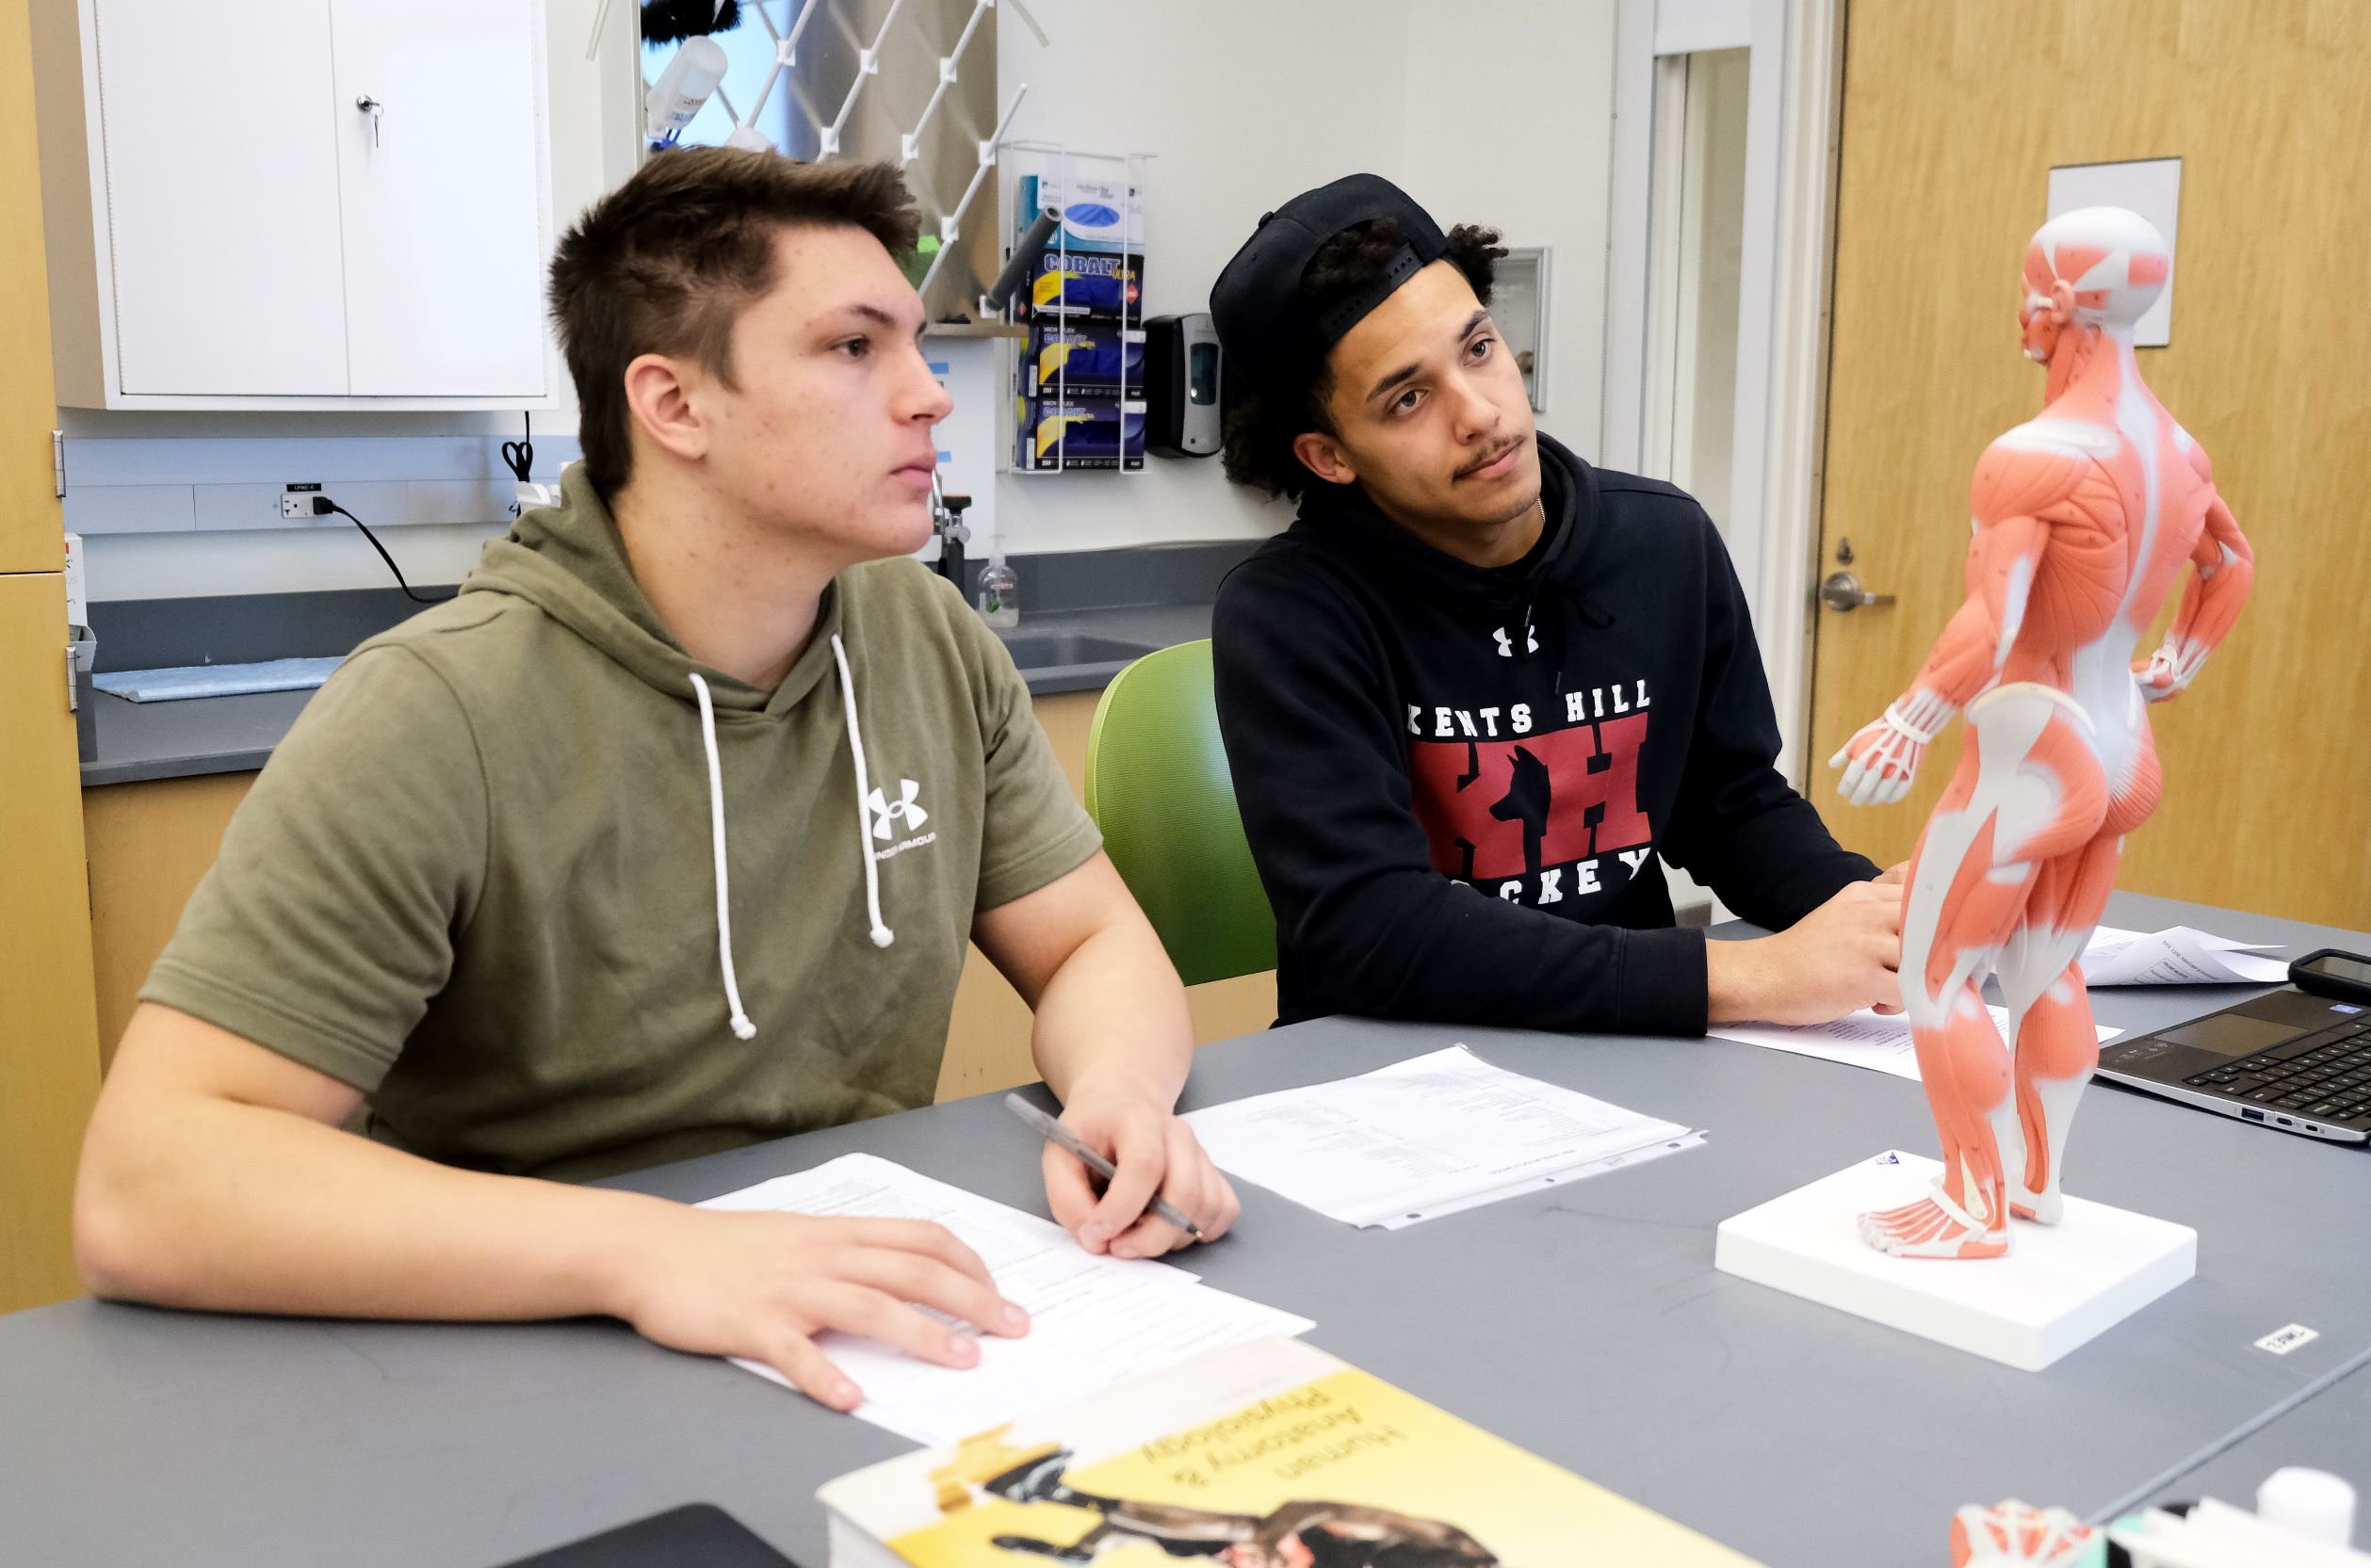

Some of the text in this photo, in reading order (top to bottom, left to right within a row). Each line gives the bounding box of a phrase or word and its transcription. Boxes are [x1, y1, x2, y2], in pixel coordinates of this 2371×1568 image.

[1044, 253, 1121, 276] COBALT
[1407, 679, 1650, 737] KENTS HILL
[1451, 847, 1651, 905] CKEY
[1140, 1385, 1332, 1463] Physiology
[1206, 1404, 1362, 1473] Anatomy
[1274, 1424, 1408, 1479] Human
